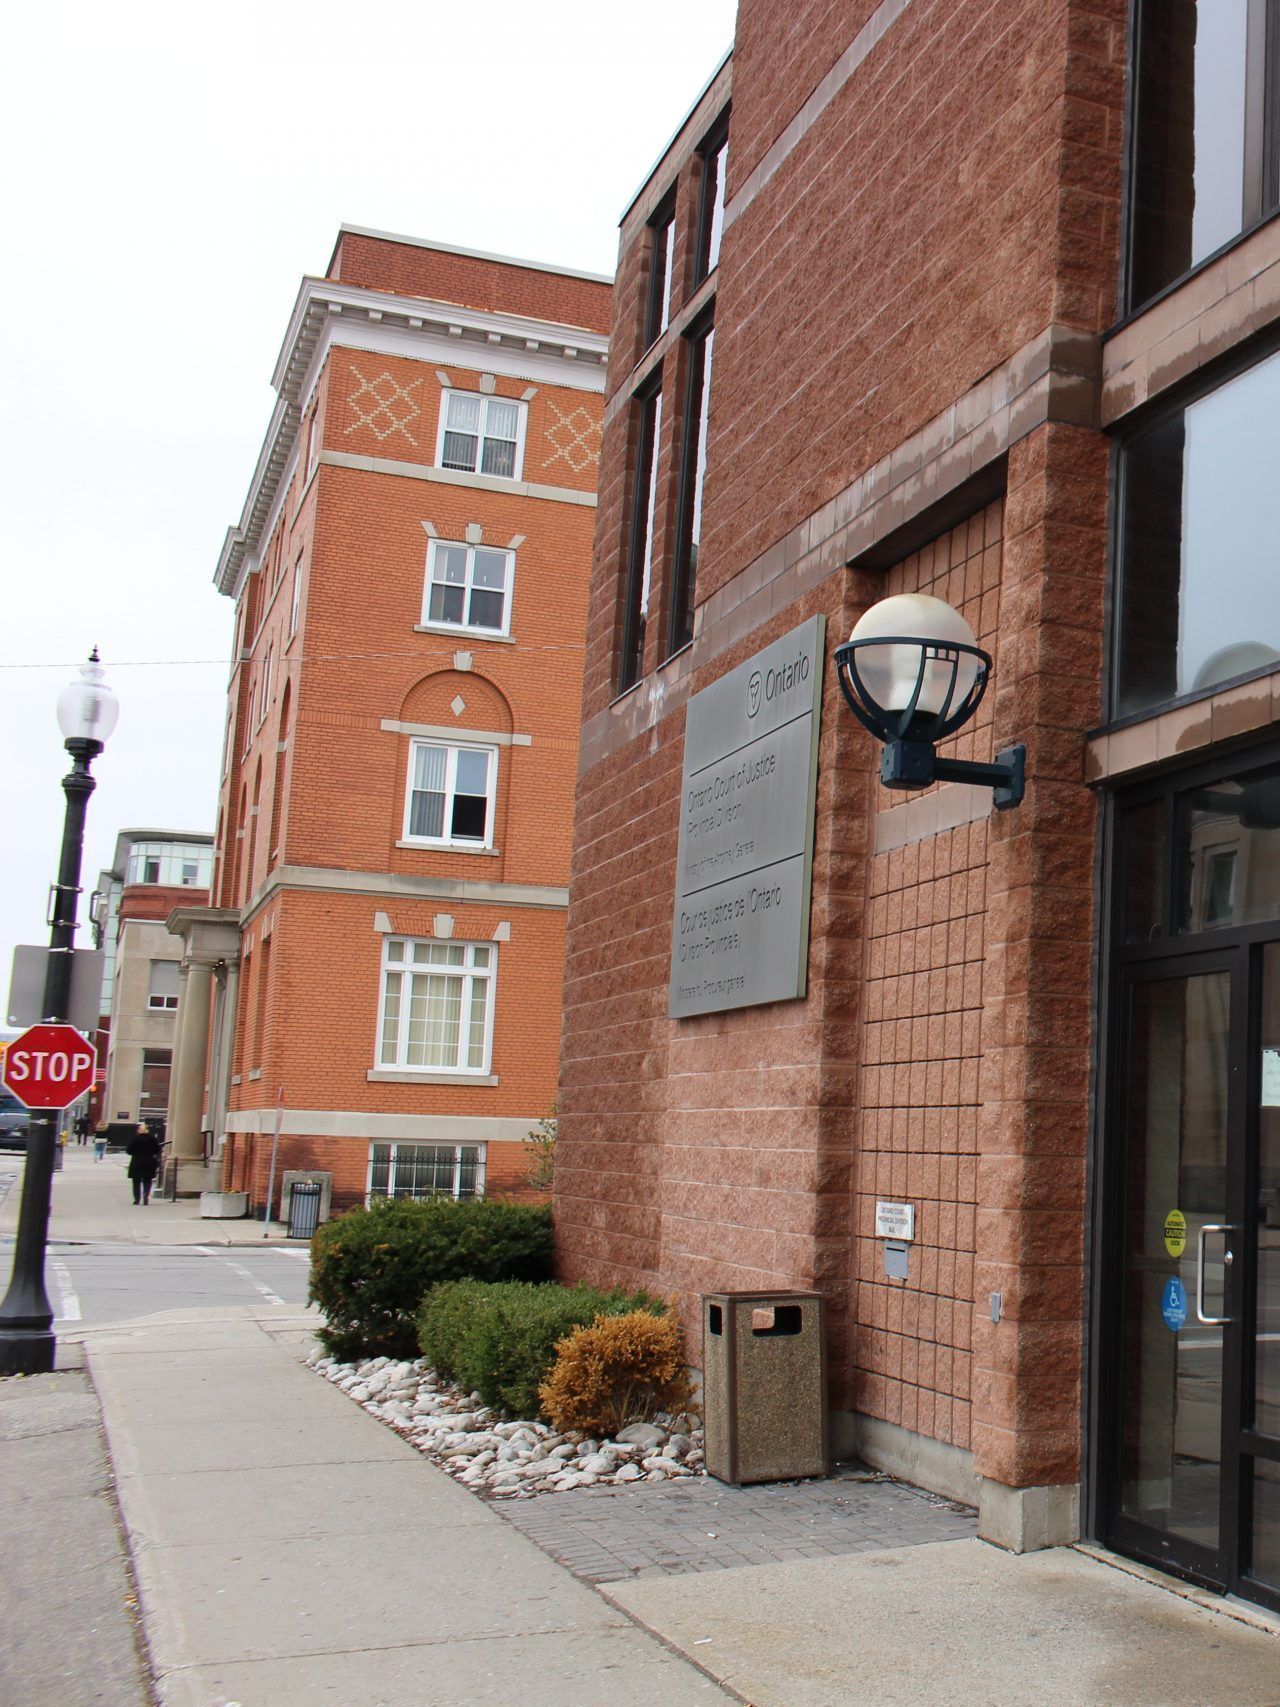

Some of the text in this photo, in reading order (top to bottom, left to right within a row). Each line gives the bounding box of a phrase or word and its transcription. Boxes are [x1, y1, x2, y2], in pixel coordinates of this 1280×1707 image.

[765, 652, 810, 702] Ontario
[688, 753, 775, 813] Ontario Court of Justice
[10, 1050, 91, 1082] STOP
